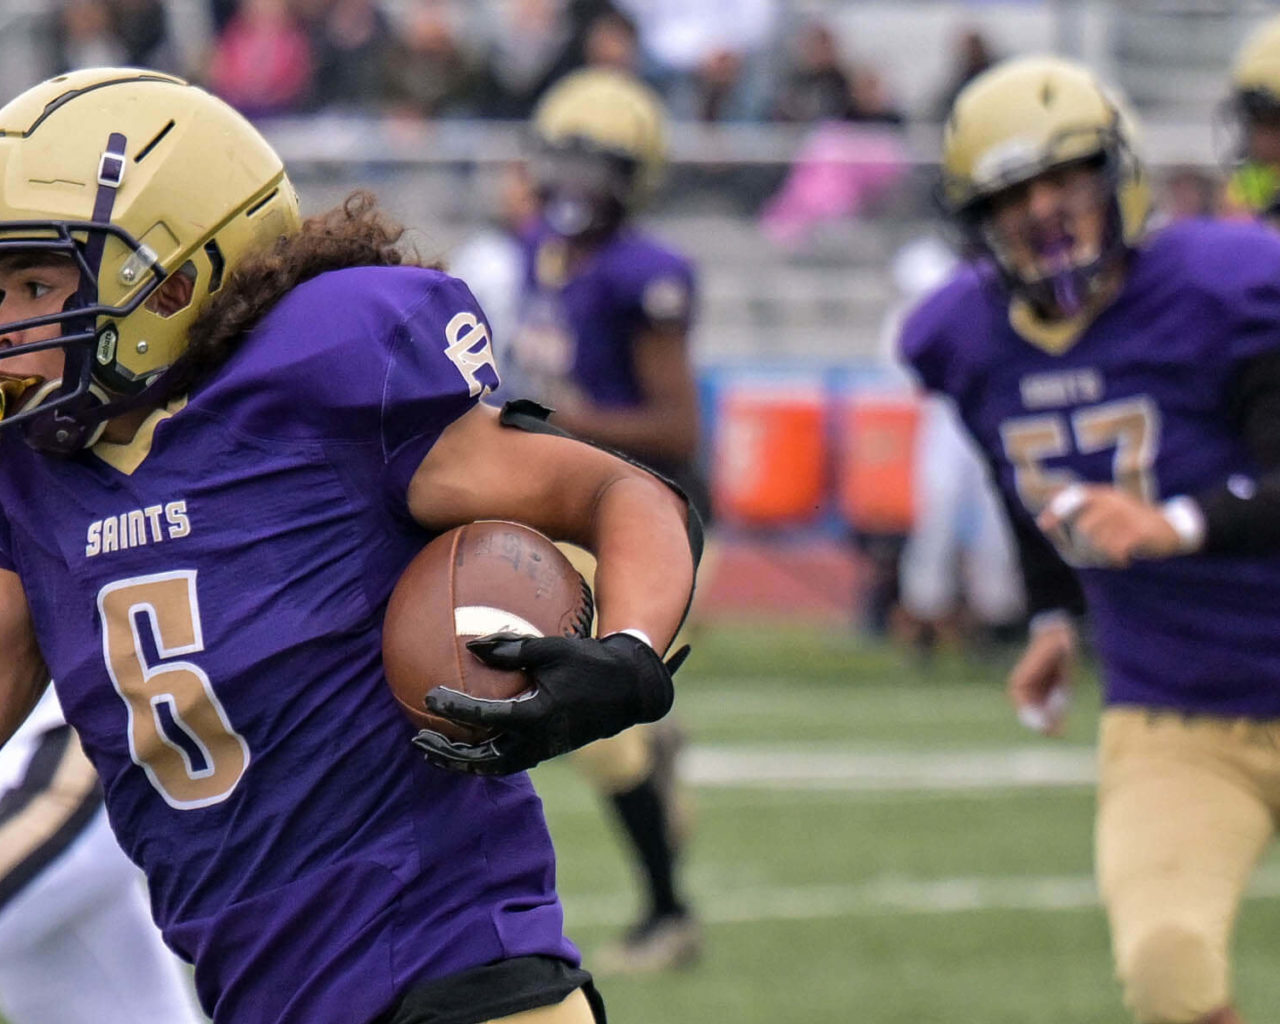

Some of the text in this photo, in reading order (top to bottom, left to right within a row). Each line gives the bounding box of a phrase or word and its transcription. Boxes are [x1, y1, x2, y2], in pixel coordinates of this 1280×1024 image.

[999, 394, 1160, 512] 57
[85, 500, 191, 557] SAINTS
[96, 569, 251, 811] 6
